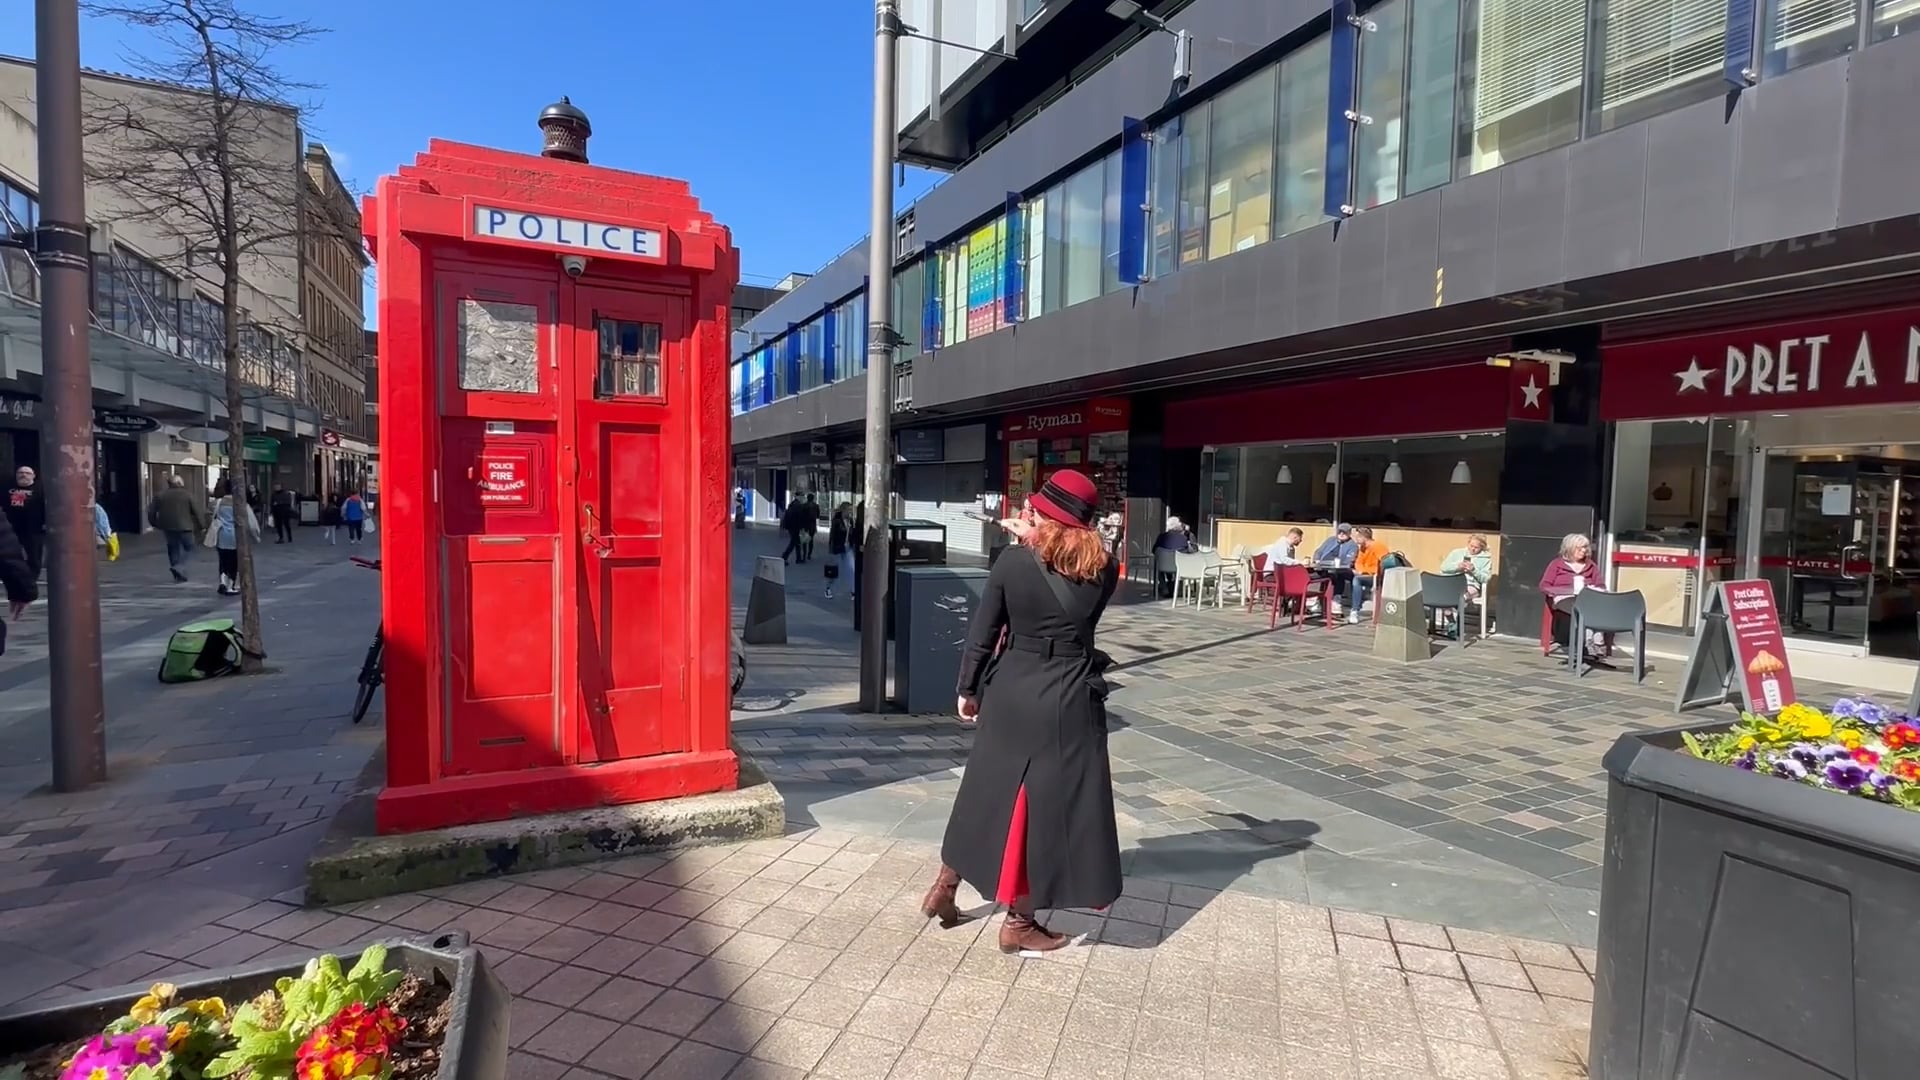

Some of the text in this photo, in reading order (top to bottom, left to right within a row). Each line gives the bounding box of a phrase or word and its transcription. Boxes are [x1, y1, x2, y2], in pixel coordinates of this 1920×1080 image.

[489, 209, 647, 255] POLICE
[1723, 334, 1831, 397] PRET
[1845, 330, 1877, 388] A
[1026, 412, 1083, 431] Ryman
[488, 462, 515, 470] POLICE
[490, 471, 514, 481] FIRE
[477, 479, 526, 491] AMBULANCE
[1797, 560, 1830, 569] LATTE
[1733, 599, 1770, 610] Subscription
